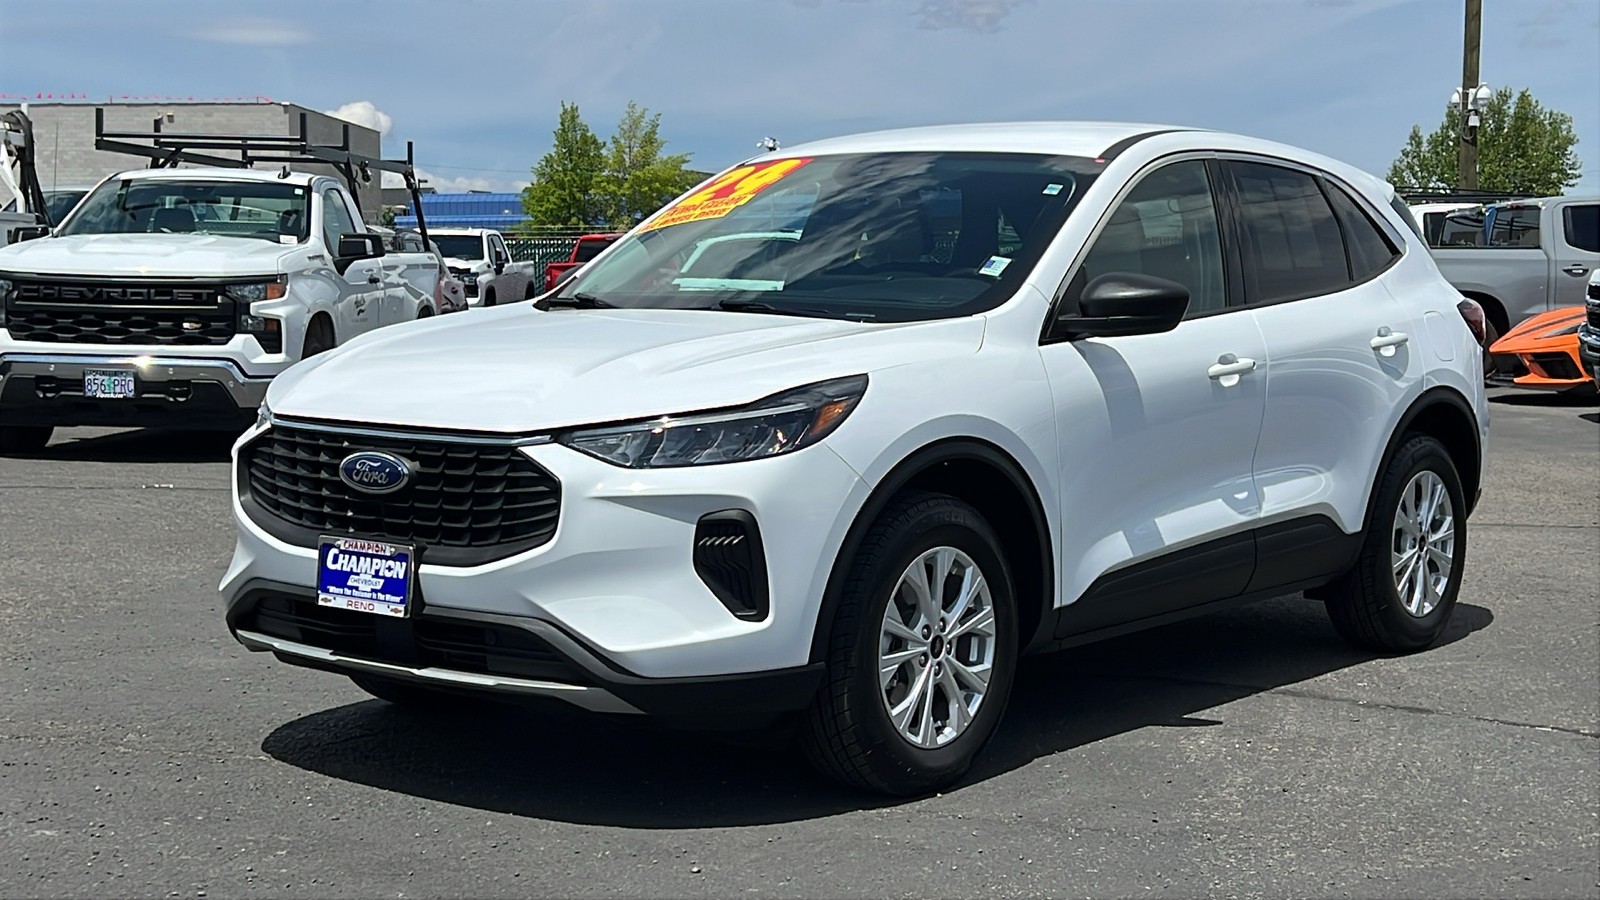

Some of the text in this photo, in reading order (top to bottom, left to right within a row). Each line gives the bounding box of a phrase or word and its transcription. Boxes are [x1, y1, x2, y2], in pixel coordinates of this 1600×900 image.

[20, 285, 215, 300] CHEVROLET
[86, 378, 134, 394] 856 PRC
[352, 459, 390, 484] Ford
[343, 540, 387, 554] CHAMPION
[326, 547, 407, 579] CHAMPION
[350, 576, 381, 587] CHEVROLET
[346, 600, 375, 611] RENO
